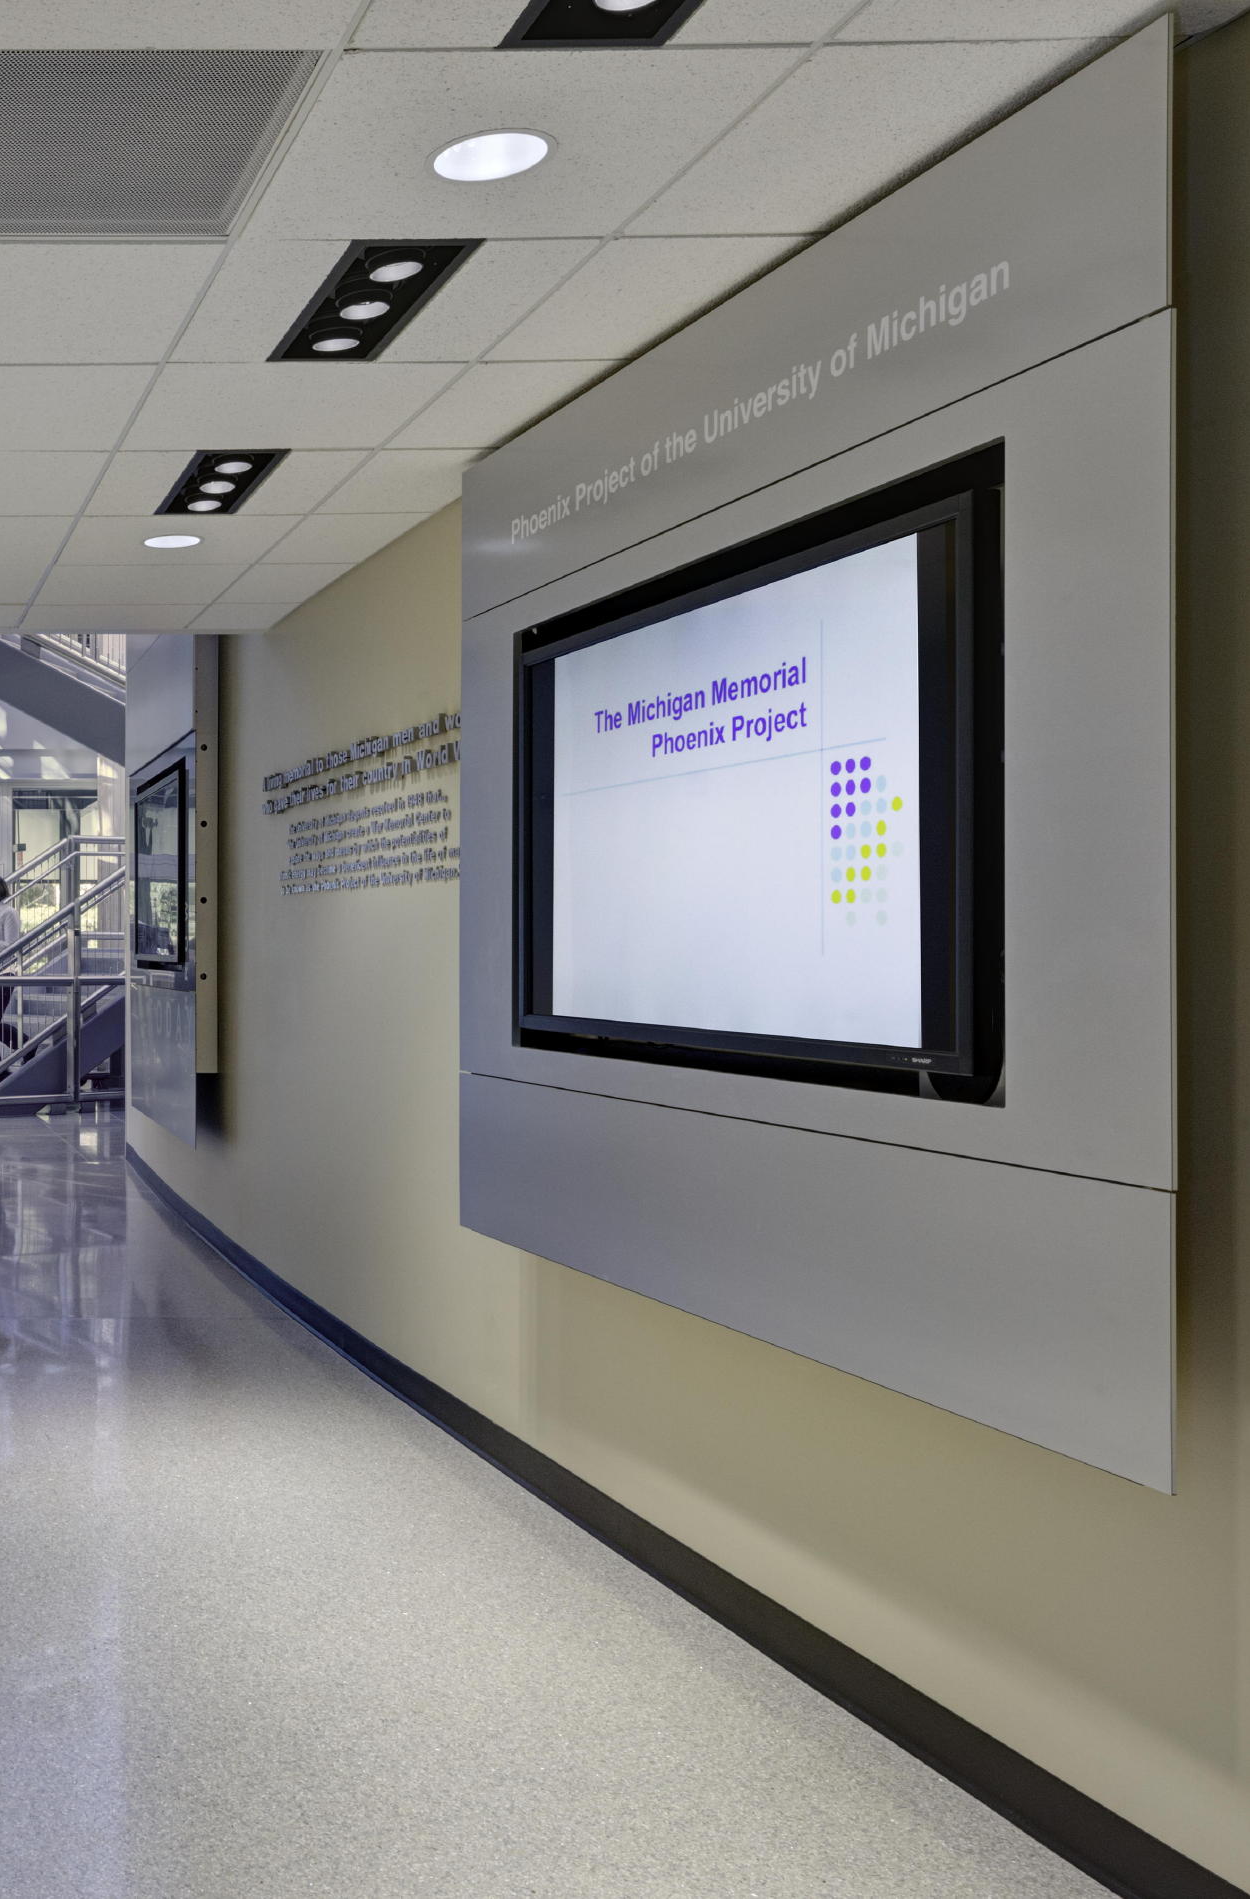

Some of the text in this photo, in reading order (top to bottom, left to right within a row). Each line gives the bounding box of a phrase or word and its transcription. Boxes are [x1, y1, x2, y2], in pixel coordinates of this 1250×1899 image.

[511, 259, 1011, 545] Phoenix Project of the University of Michigan
[594, 656, 807, 734] The Michigan Memorial
[325, 750, 349, 771] those
[350, 734, 389, 761] Michigan
[392, 727, 414, 748] men
[418, 718, 440, 739] and
[445, 713, 461, 732] wo
[652, 702, 808, 758] Phoenix Project
[363, 761, 399, 786] country
[401, 755, 412, 775] in
[416, 748, 449, 771] World
